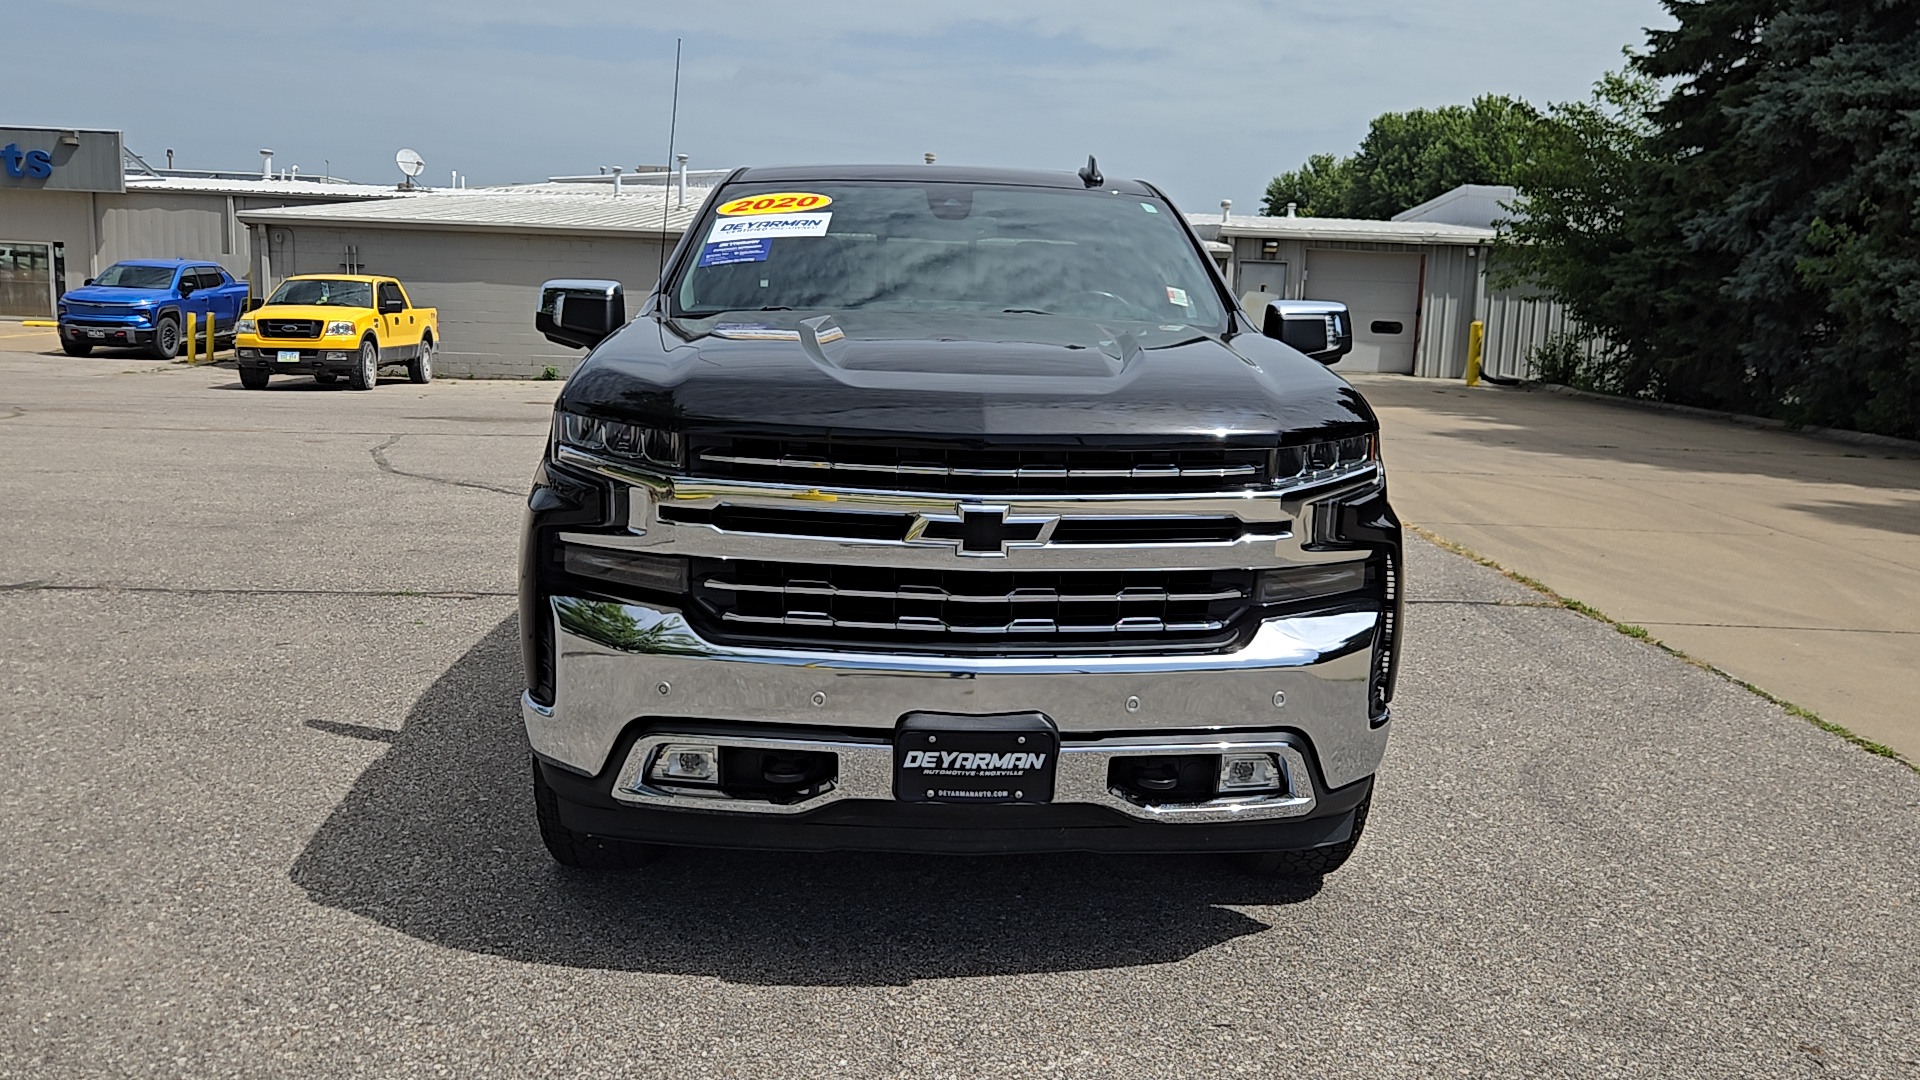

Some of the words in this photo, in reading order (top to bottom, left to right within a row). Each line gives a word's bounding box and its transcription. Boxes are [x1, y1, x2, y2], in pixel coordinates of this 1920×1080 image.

[728, 196, 820, 214] 2020
[720, 219, 823, 232] DEYARMAN
[903, 751, 1046, 769] DEYARMAN
[938, 790, 1008, 798] DEYARMANAUTO.COM
